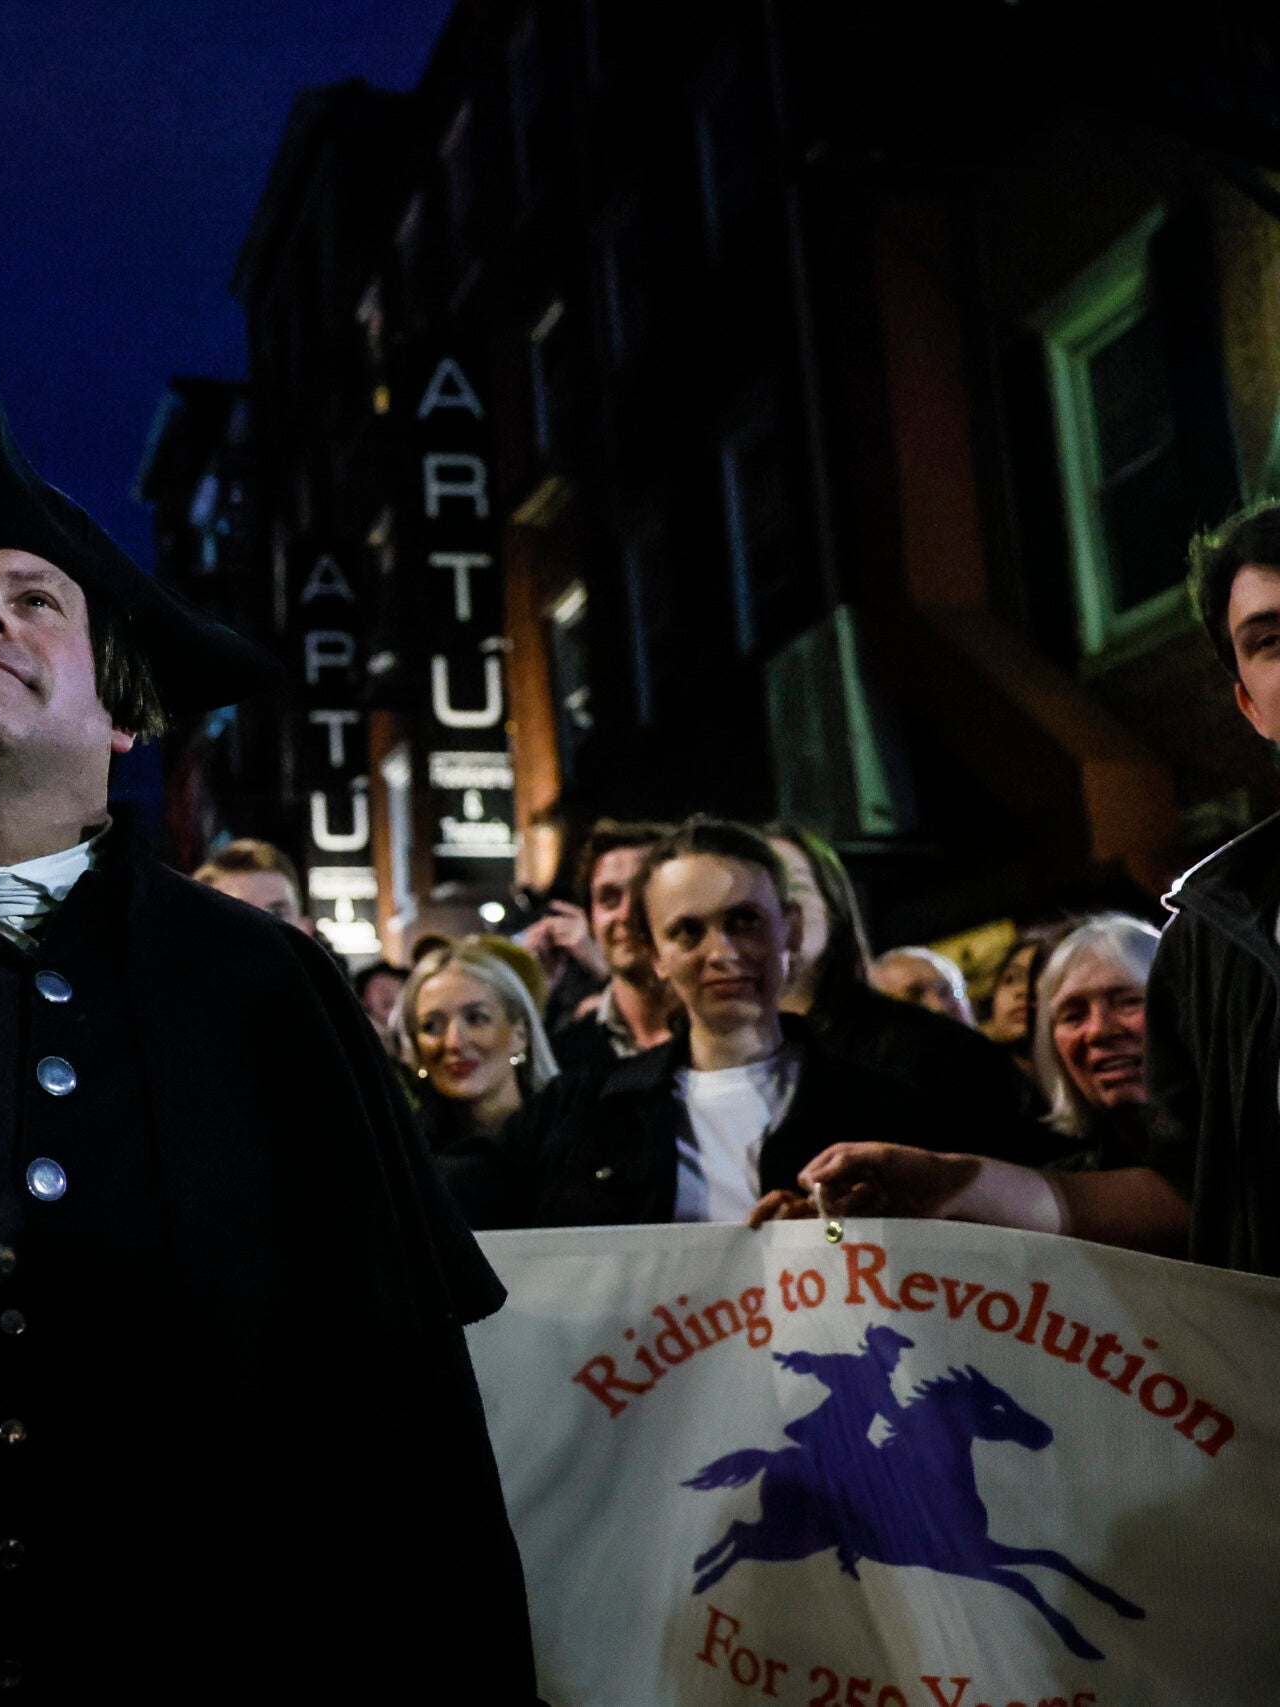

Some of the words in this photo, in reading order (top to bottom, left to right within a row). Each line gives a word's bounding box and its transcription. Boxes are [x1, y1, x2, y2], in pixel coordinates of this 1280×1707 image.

[573, 1287, 773, 1419] Riding
[778, 1268, 826, 1312] to
[841, 1241, 1238, 1458] Revolution
[696, 1604, 787, 1698] For
